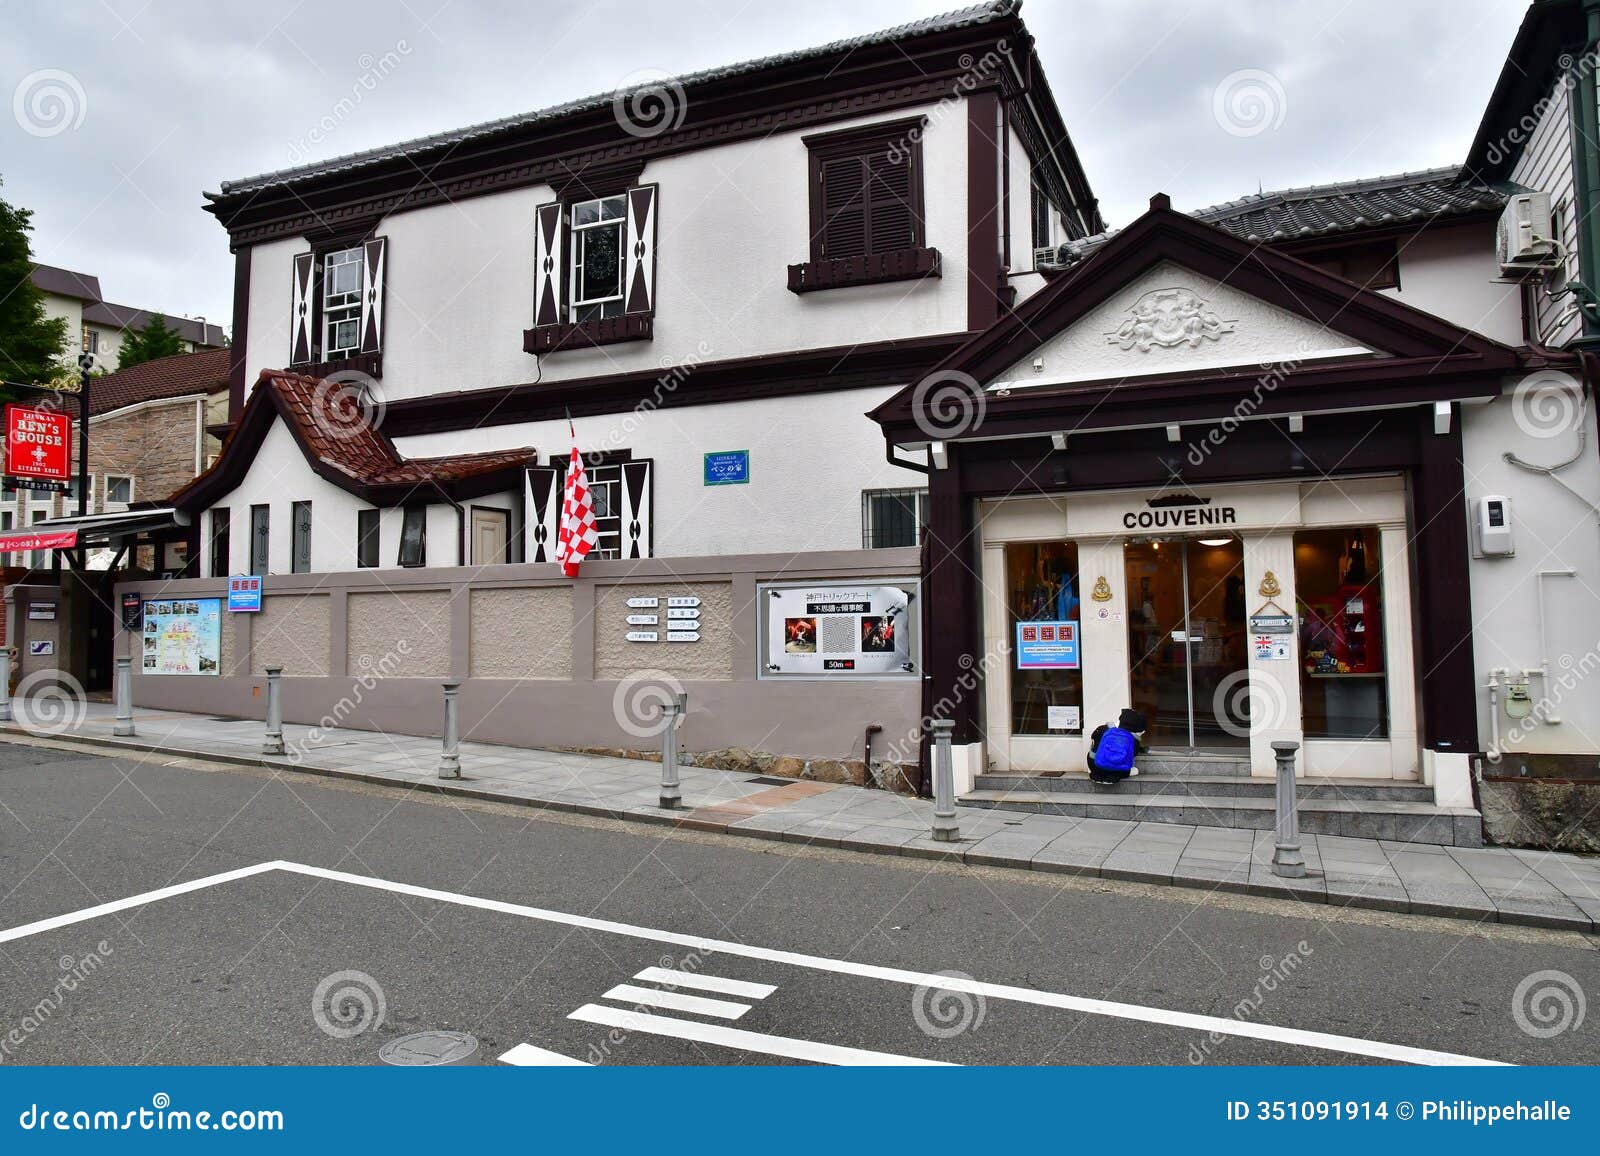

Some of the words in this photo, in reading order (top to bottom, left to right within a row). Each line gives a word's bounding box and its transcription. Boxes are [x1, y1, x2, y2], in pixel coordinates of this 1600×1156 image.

[17, 419, 59, 434] BEN'S
[17, 431, 62, 446] HOUSE
[1123, 507, 1236, 529] COUVENIR
[828, 660, 844, 669] 50m
